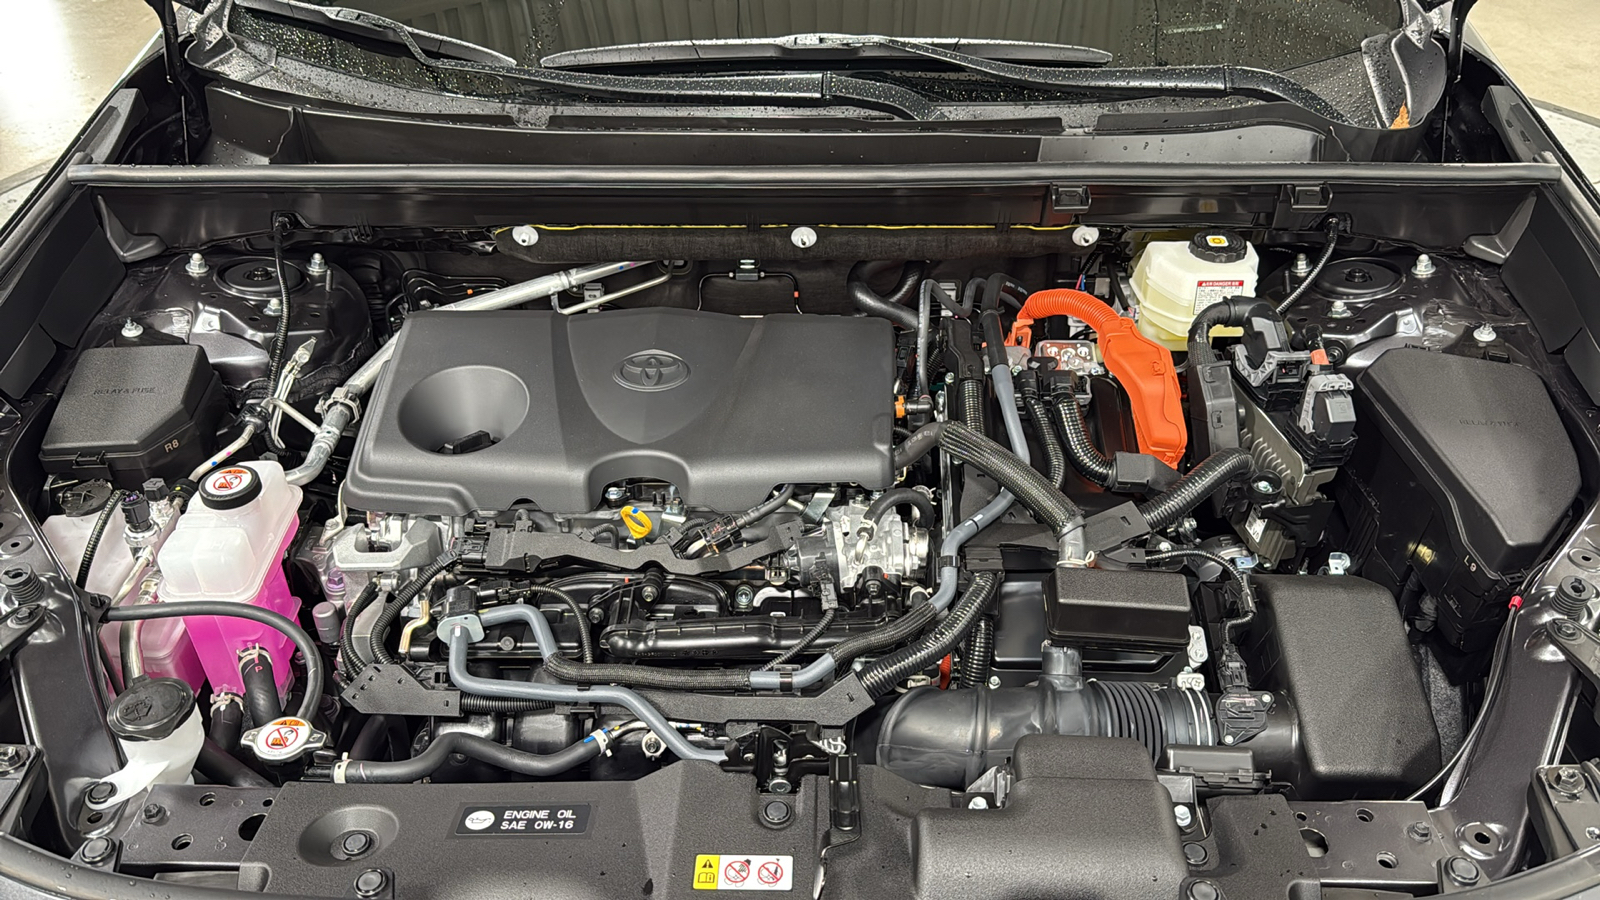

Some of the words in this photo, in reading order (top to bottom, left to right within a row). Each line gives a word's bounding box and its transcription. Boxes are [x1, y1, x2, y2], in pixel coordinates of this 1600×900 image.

[164, 439, 179, 453] R8
[503, 810, 550, 819] ENGINE
[557, 809, 576, 818] OIL
[500, 821, 527, 829] SAE
